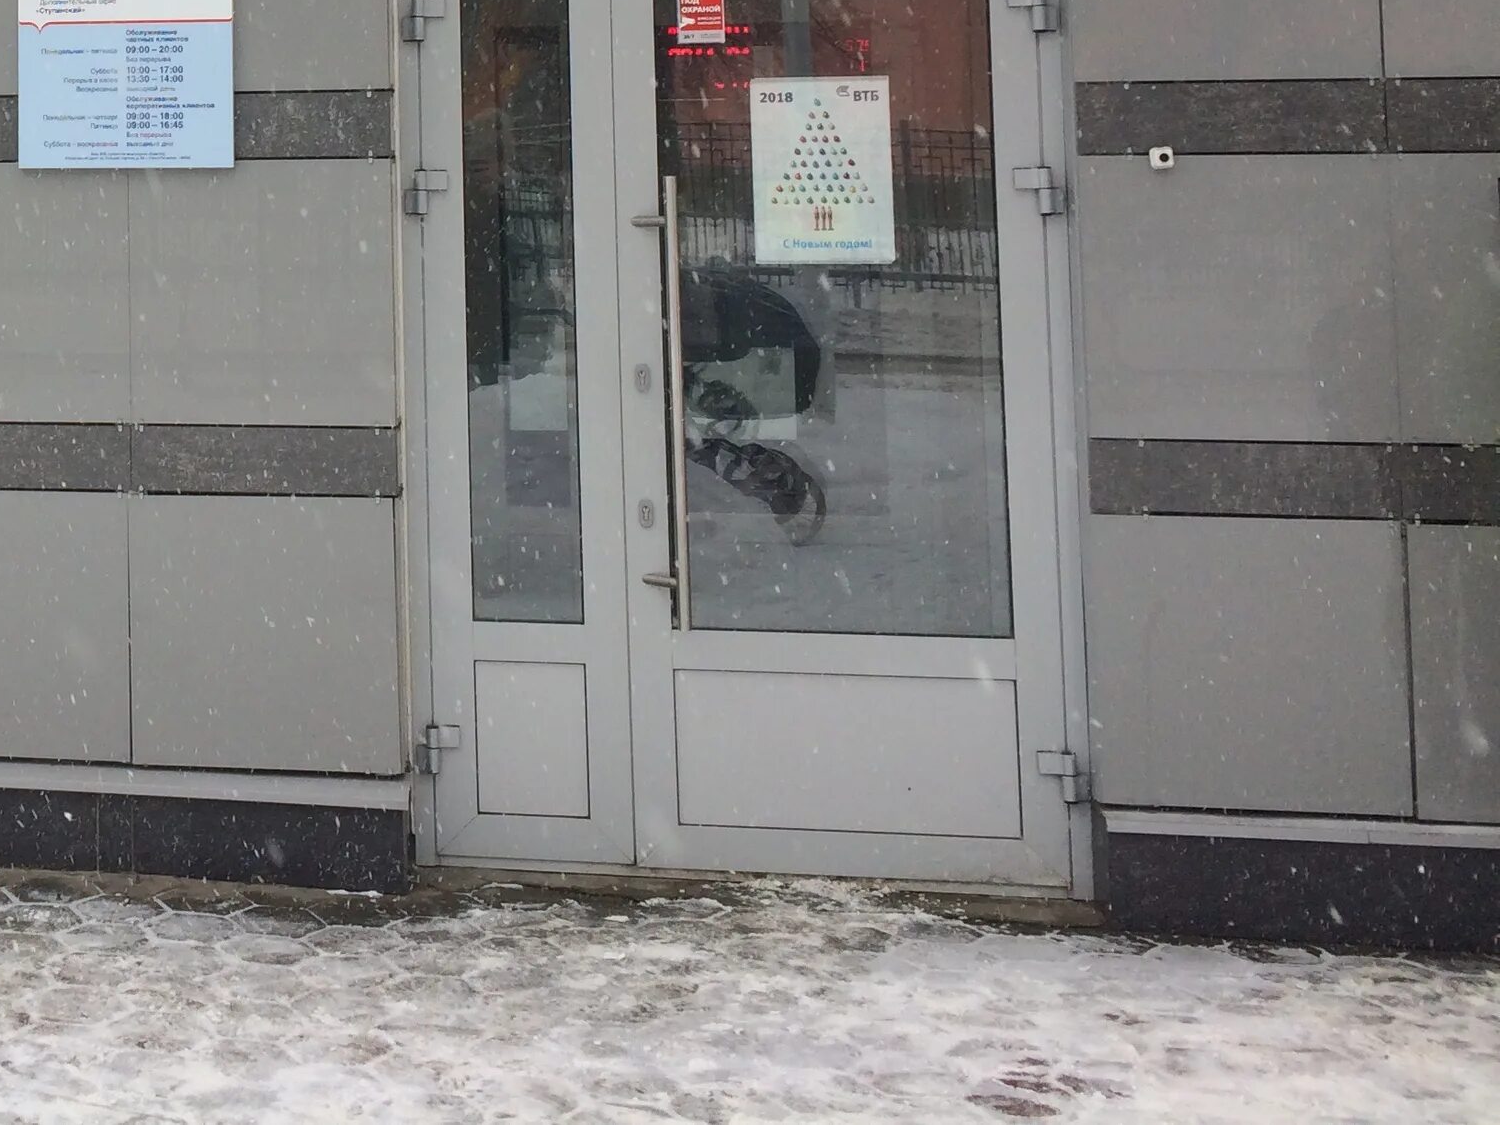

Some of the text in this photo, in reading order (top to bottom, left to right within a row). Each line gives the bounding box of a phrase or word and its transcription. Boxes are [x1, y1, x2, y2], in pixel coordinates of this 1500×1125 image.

[681, 5, 721, 14] ОХРАНОЙ
[159, 45, 183, 53] 20:00
[126, 66, 150, 74] 10:00
[160, 65, 183, 74] 17:00
[160, 74, 183, 83] 14:00
[759, 90, 880, 103] 2018 ВТБ
[126, 112, 150, 120] 09:00
[160, 112, 183, 120] 18:00
[126, 121, 150, 129] 09:00
[160, 121, 183, 129] 16:45
[783, 239, 872, 250] С Новым годом!
